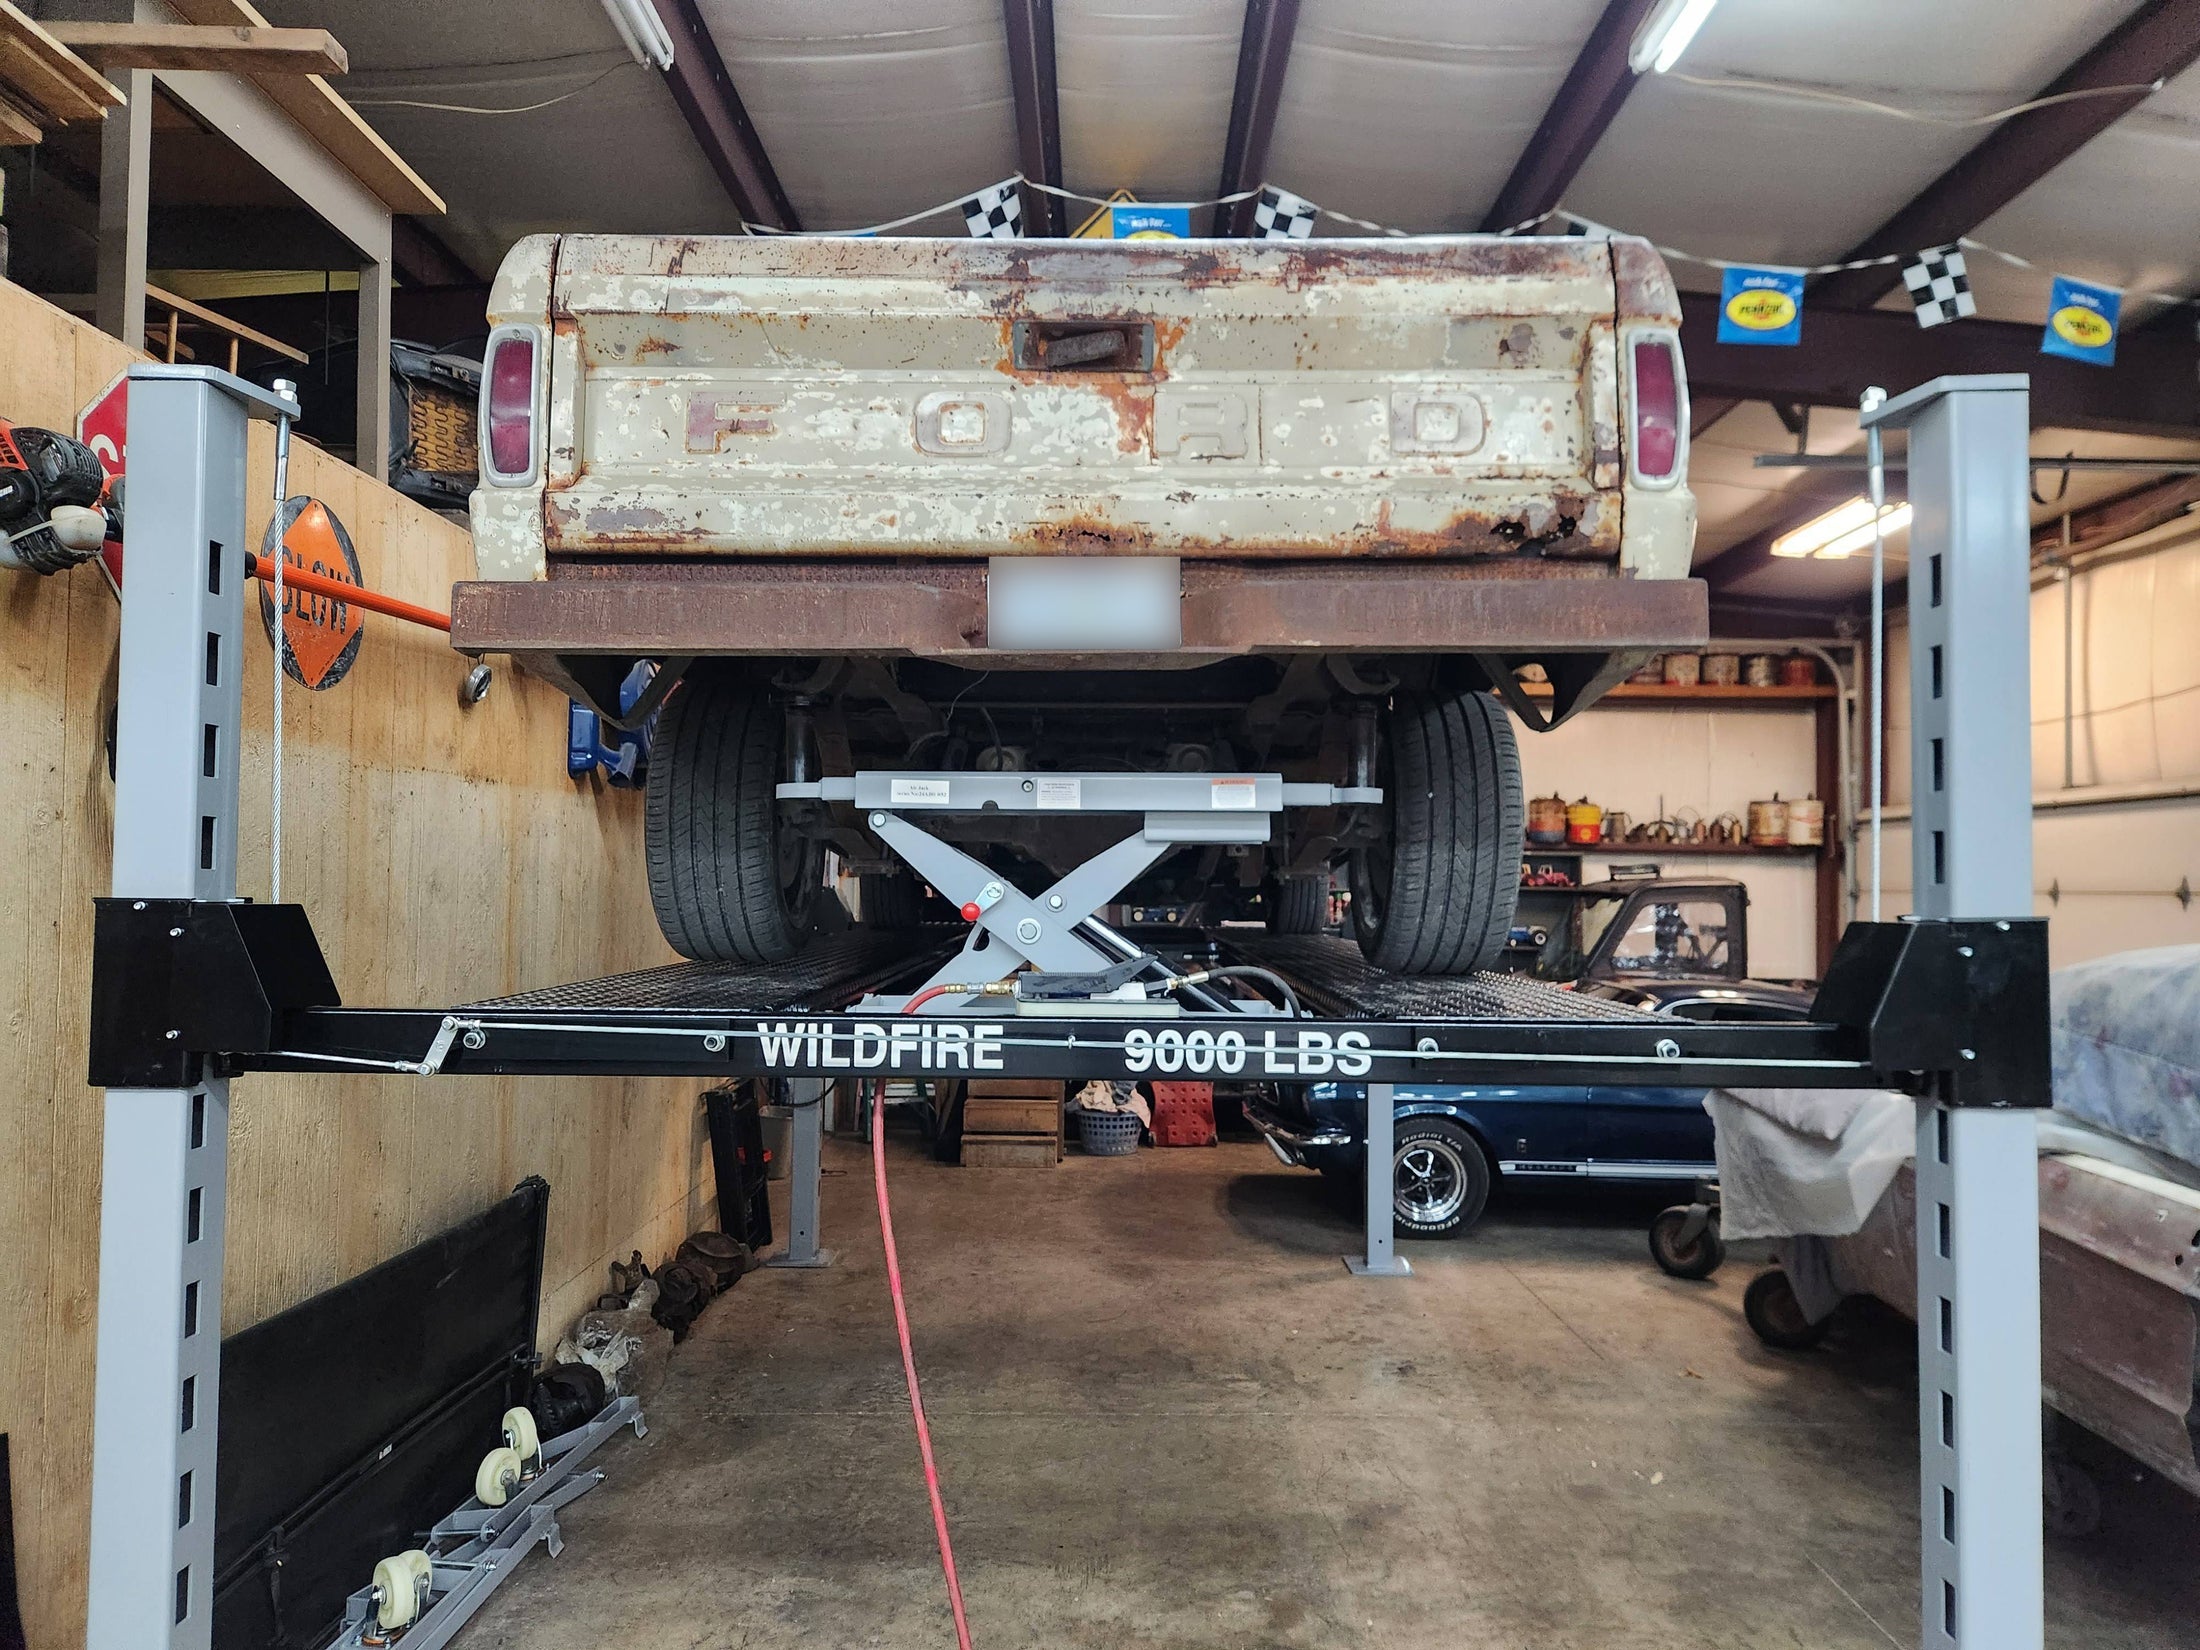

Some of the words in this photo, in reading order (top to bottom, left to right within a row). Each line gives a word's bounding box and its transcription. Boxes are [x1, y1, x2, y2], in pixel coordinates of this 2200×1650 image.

[685, 390, 1487, 457] FORD
[279, 544, 352, 635] SLOW
[757, 1022, 1004, 1070] WILDFIRE
[1124, 1029, 1246, 1074] 9000
[1264, 1030, 1372, 1076] LBS
[1401, 1132, 1442, 1145] Radial
